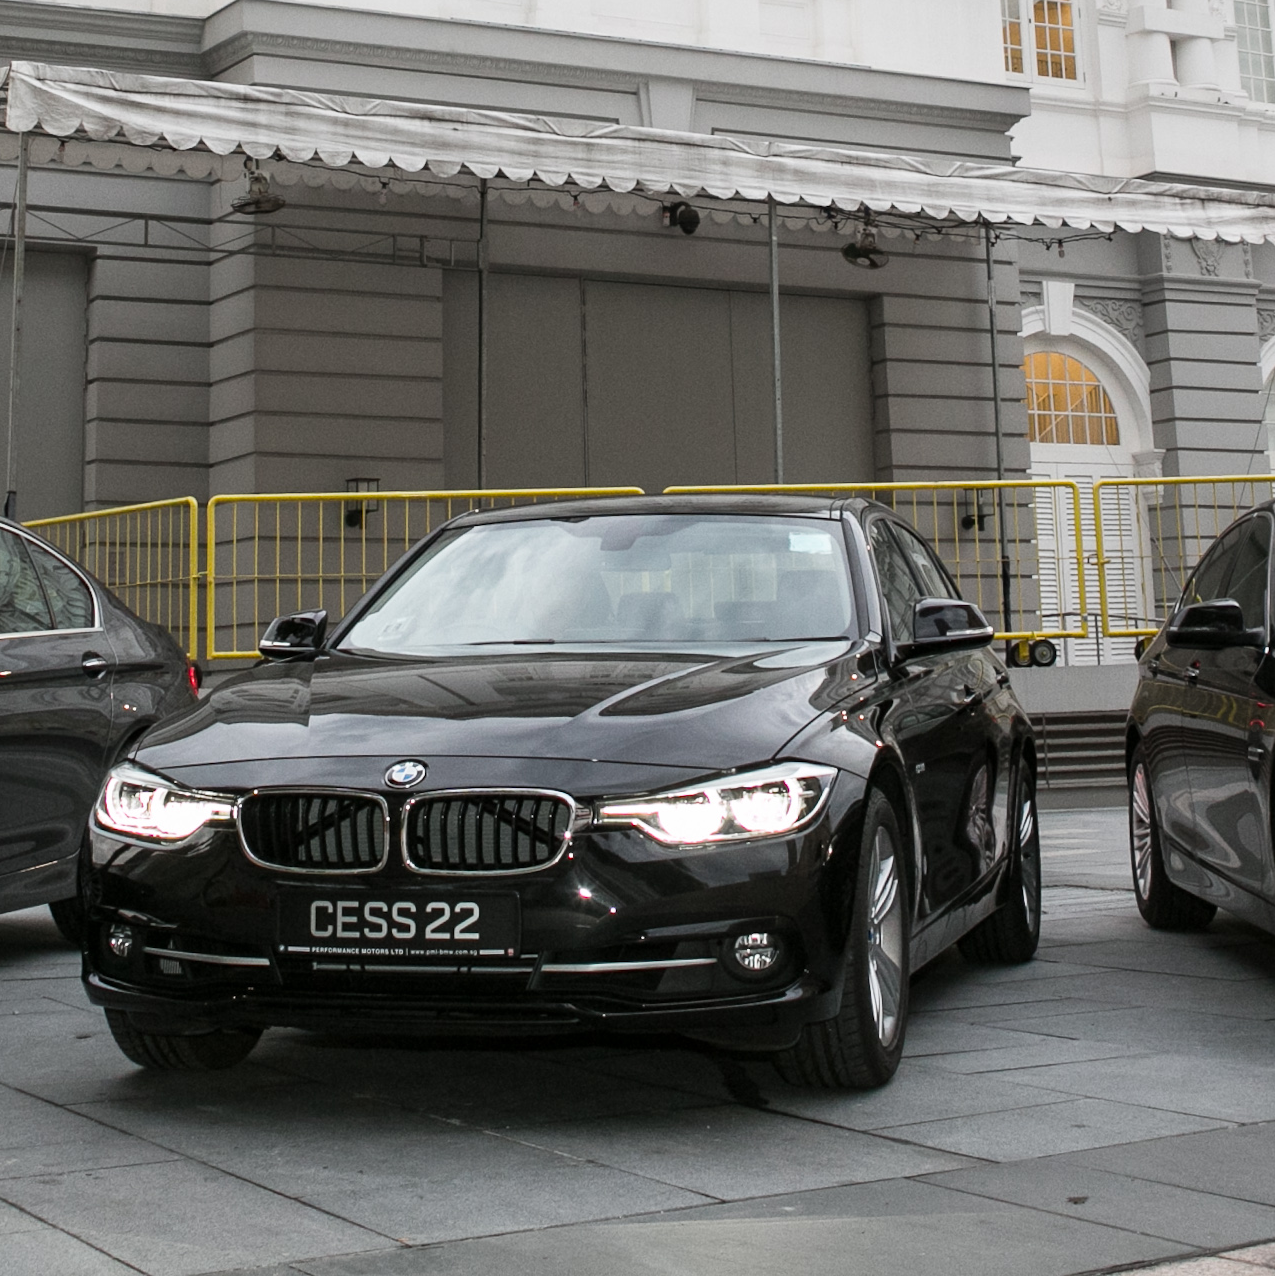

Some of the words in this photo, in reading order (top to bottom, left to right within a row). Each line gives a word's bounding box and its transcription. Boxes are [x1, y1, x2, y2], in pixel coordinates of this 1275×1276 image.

[310, 900, 416, 939] CESS
[425, 902, 480, 940] 22
[311, 946, 359, 955] PERFORMANCE
[361, 948, 389, 956] MOTORS
[390, 948, 404, 956] LTD
